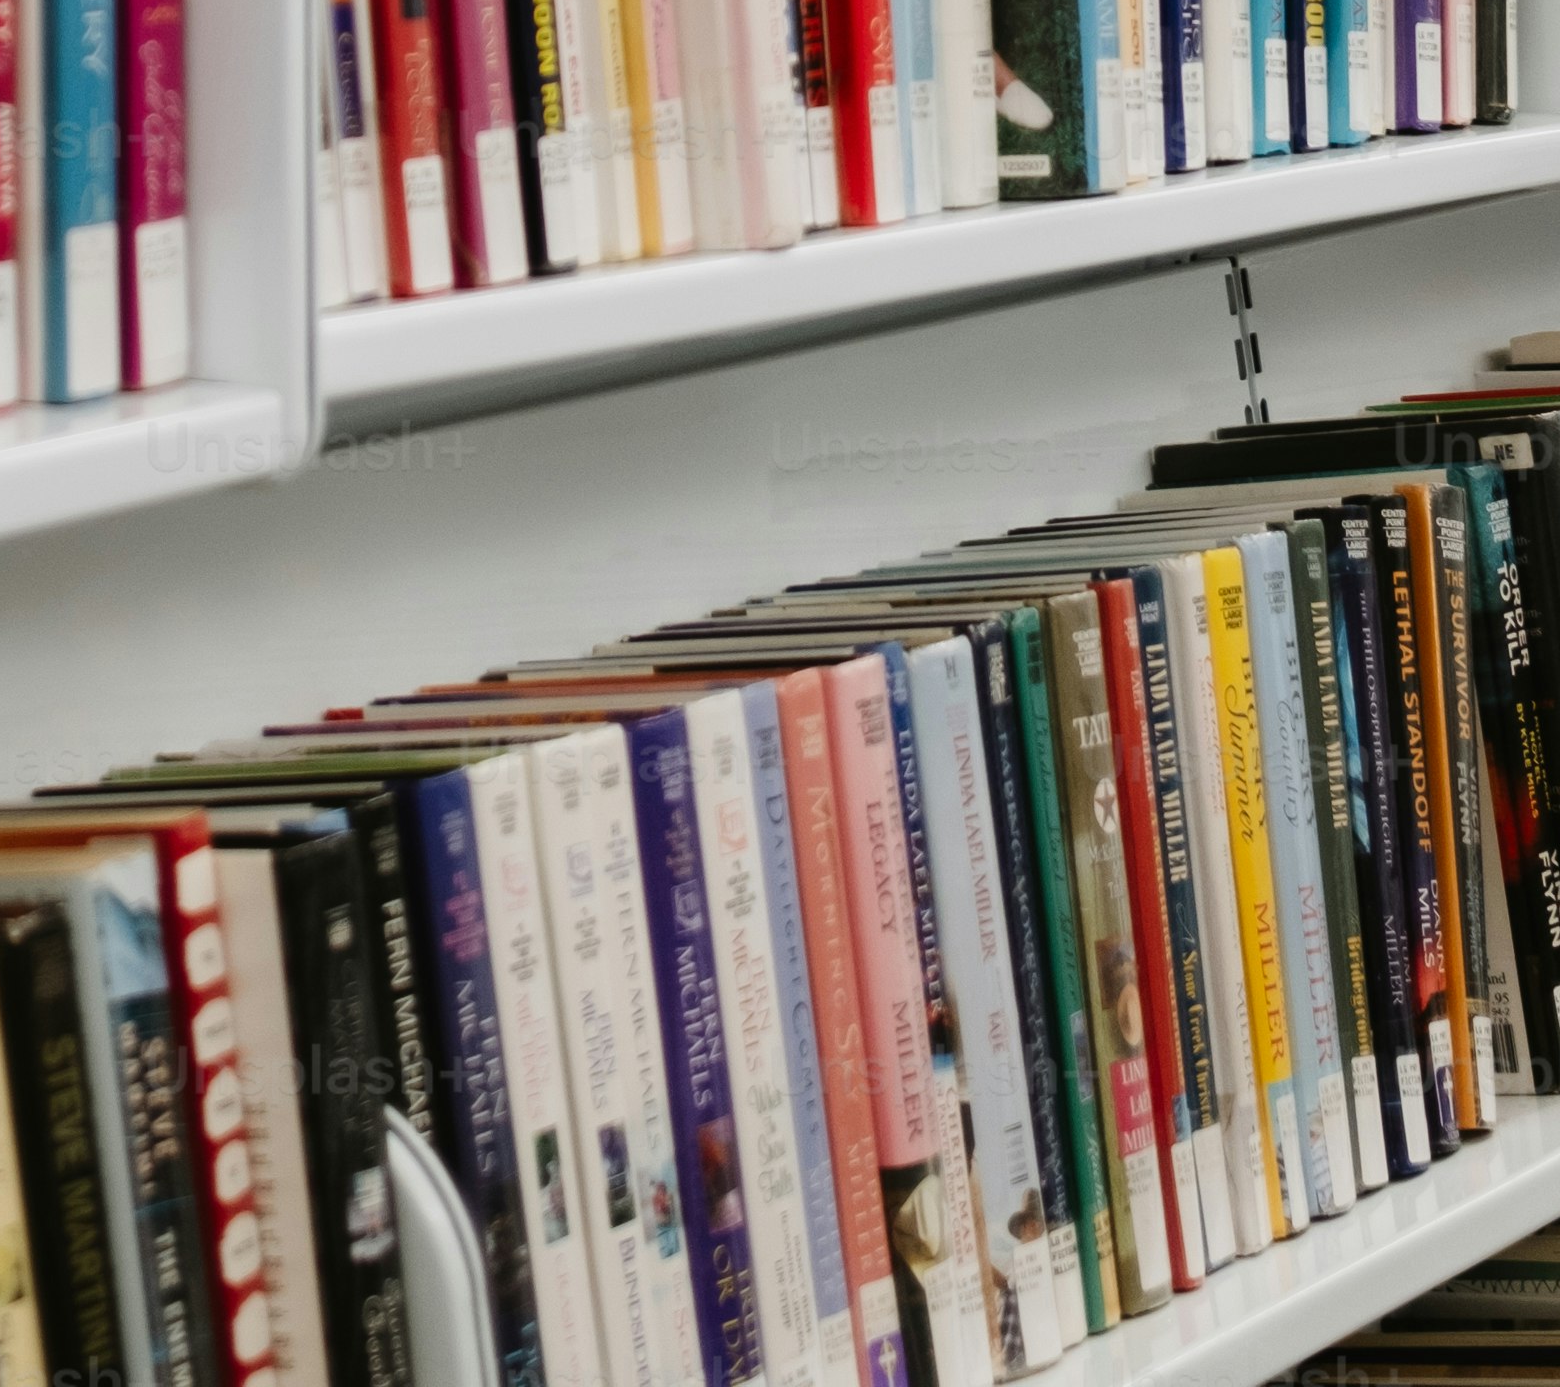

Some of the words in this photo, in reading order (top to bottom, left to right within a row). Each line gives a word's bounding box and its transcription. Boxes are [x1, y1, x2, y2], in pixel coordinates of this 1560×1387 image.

[1001, 157, 1047, 173] 1232937
[1493, 443, 1515, 461] NE
[1381, 508, 1408, 520] CENTER
[1435, 516, 1466, 530] CENTER
[1444, 567, 1466, 589] THE
[1496, 559, 1512, 604] TO
[1509, 562, 1531, 670] ORDER
[1391, 569, 1416, 683] LETHAL
[1450, 595, 1472, 742] SURVIVOR
[1502, 608, 1519, 677] KILL
[1145, 643, 1167, 722] LINDA
[1310, 601, 1331, 672] LINDA
[1326, 738, 1350, 830] MILLER
[1154, 726, 1174, 783] LAEL
[1402, 690, 1433, 855] STANDOFF
[897, 728, 923, 834] LINDA
[912, 836, 933, 897] LAEL
[1162, 789, 1188, 883] MILLER
[1455, 759, 1474, 846] FLYNN
[865, 799, 898, 937] LEGACY
[1382, 913, 1405, 1007] MILLER
[1417, 886, 1435, 971] MILLS
[1429, 877, 1447, 977] DIANN
[1254, 901, 1285, 1066] MILLER
[1297, 883, 1333, 1066] MILLER
[673, 945, 713, 1109] MICHAELS
[891, 1000, 925, 1143] MILLER
